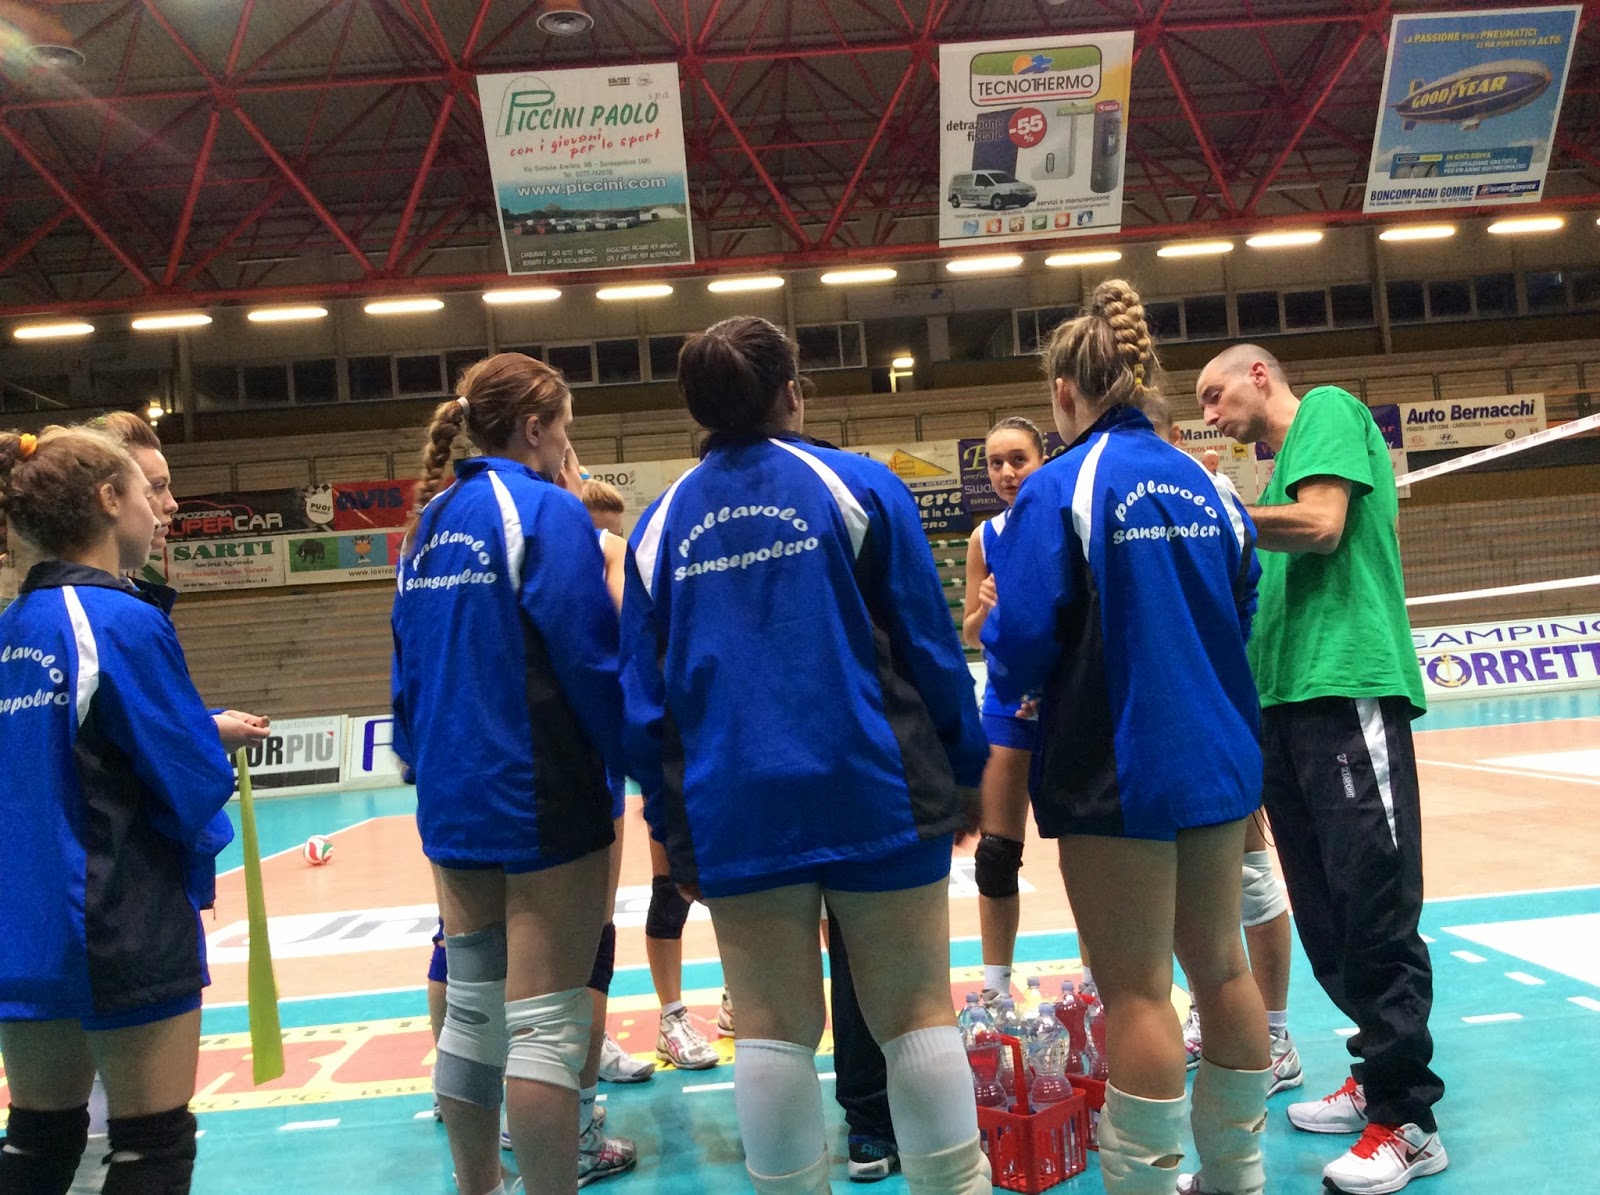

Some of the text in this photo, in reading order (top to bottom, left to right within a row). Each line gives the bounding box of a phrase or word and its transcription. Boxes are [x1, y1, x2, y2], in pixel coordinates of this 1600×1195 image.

[1414, 32, 1460, 43] PASSIONE
[1480, 28, 1537, 39] PNEUMATICI
[1497, 40, 1527, 48] PORTATO
[978, 74, 1094, 97] TECNOTHERMO
[505, 90, 659, 135] PICCINI PAOLO
[946, 119, 1003, 132] detrazione
[1009, 114, 1043, 136] -55
[510, 128, 602, 157] con i giovani
[570, 128, 662, 160] per lo sport
[967, 130, 1003, 142] fiscale
[1024, 135, 1035, 143] %
[516, 177, 667, 197] www.piccini.com
[1370, 188, 1438, 201] BONCOMPAGNI
[1440, 185, 1475, 197] GOMME
[1065, 194, 1110, 204] manutenzione
[1406, 399, 1535, 425] Auto Bernacchi
[1180, 429, 1222, 441] Mann
[1183, 444, 1228, 454] TROLIFERI
[310, 503, 331, 512] PUOI
[336, 487, 404, 512] AVIS
[1114, 479, 1218, 523] pallavolo
[171, 509, 232, 521] RROZZERIA
[932, 509, 941, 517] in
[944, 507, 964, 517] C.A.
[170, 512, 283, 536] UPERCAR
[678, 505, 809, 558] pallavolo
[923, 521, 947, 529] CRO
[173, 540, 275, 561] SARTI
[413, 530, 490, 571] pallavolo
[674, 537, 818, 581] sansepolcro
[224, 558, 254, 567] Agricola
[1, 645, 63, 684] lavolo
[1418, 642, 1600, 688] ORRETT
[280, 719, 334, 731] cartotecnica
